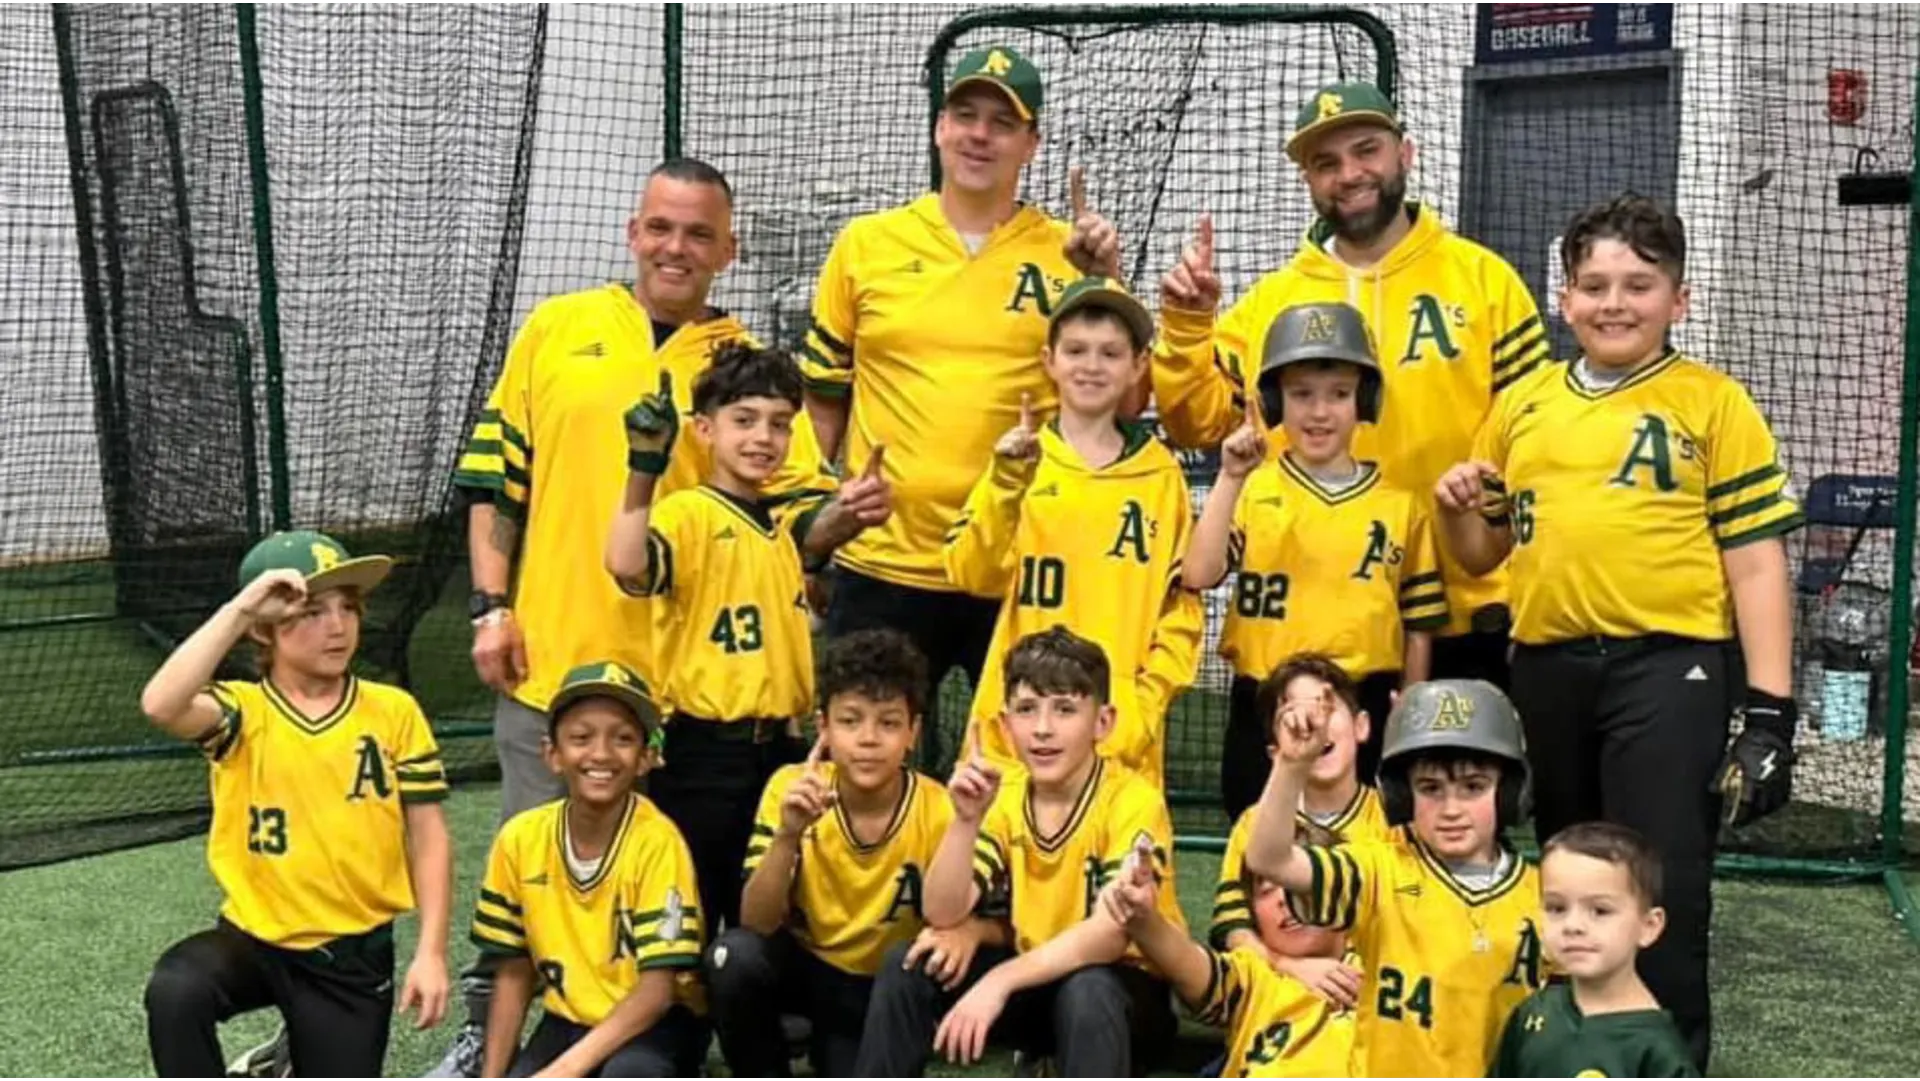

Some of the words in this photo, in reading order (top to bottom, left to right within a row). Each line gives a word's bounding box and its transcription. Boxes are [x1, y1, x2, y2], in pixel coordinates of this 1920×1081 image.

[1005, 262, 1064, 317] A's
[1401, 294, 1466, 361] A's
[1608, 413, 1695, 491] A's
[1107, 500, 1158, 563] A's
[1351, 519, 1403, 580] A's
[1019, 555, 1065, 608] 10
[1236, 571, 1289, 620] 82
[710, 604, 763, 653] 43
[1376, 966, 1432, 1028] 24
